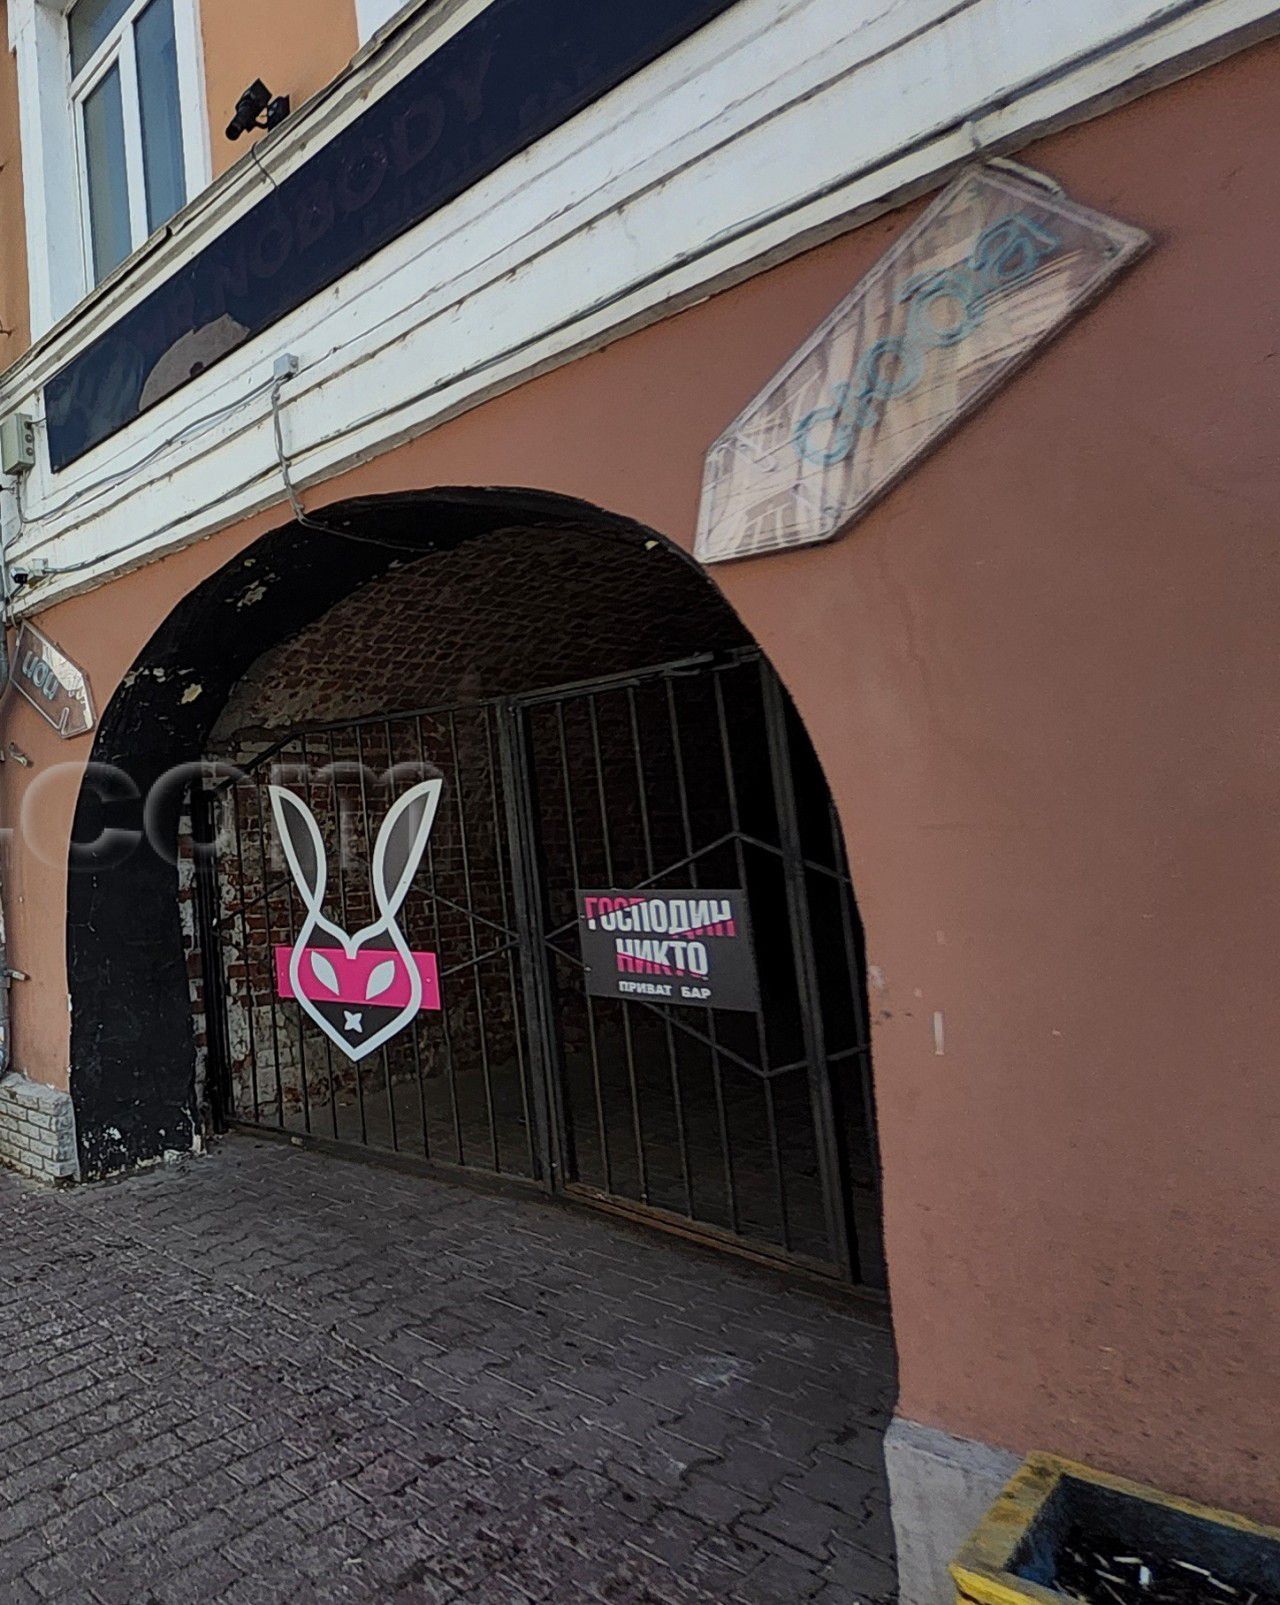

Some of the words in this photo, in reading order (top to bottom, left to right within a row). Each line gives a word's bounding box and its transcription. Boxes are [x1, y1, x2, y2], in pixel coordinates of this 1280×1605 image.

[583, 896, 737, 939] ГОСПОДИН
[616, 937, 710, 980] НИКТО
[618, 980, 673, 997] ПРИВАТ
[680, 986, 712, 1000] БАР
